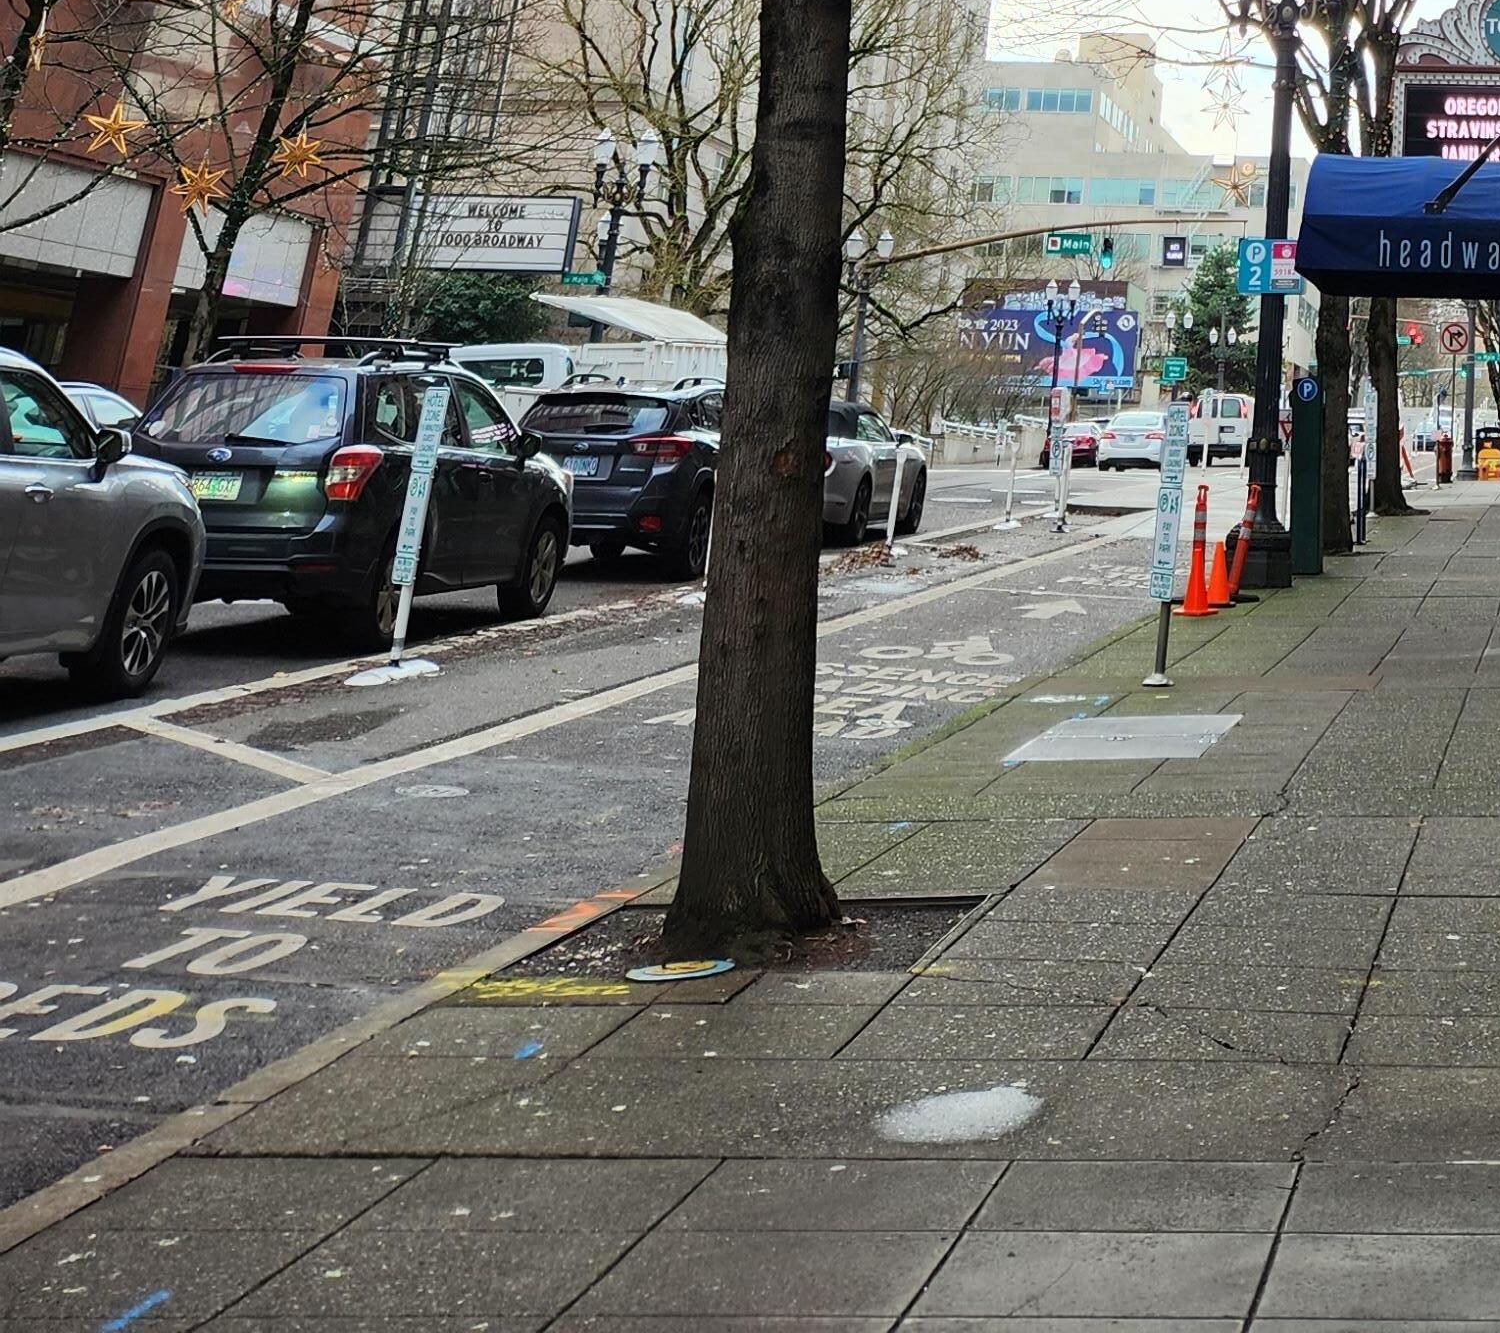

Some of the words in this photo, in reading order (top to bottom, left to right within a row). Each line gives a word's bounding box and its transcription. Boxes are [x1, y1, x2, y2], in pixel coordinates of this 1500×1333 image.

[468, 204, 526, 218] WELCOME
[487, 220, 503, 232] TO
[473, 234, 545, 248] BROADWAY
[1062, 239, 1089, 250] Main
[1249, 266, 1262, 286] 2
[990, 319, 1019, 331] 2023
[1303, 383, 1313, 397] P
[424, 410, 441, 422] ZONE
[1169, 410, 1187, 423] HOTEL
[1168, 424, 1185, 437] ZONE
[1162, 522, 1172, 530] PAY
[1160, 543, 1171, 553] PARK
[158, 875, 505, 928] YIELD
[121, 927, 307, 975] TO
[0, 981, 277, 1049] EDS
